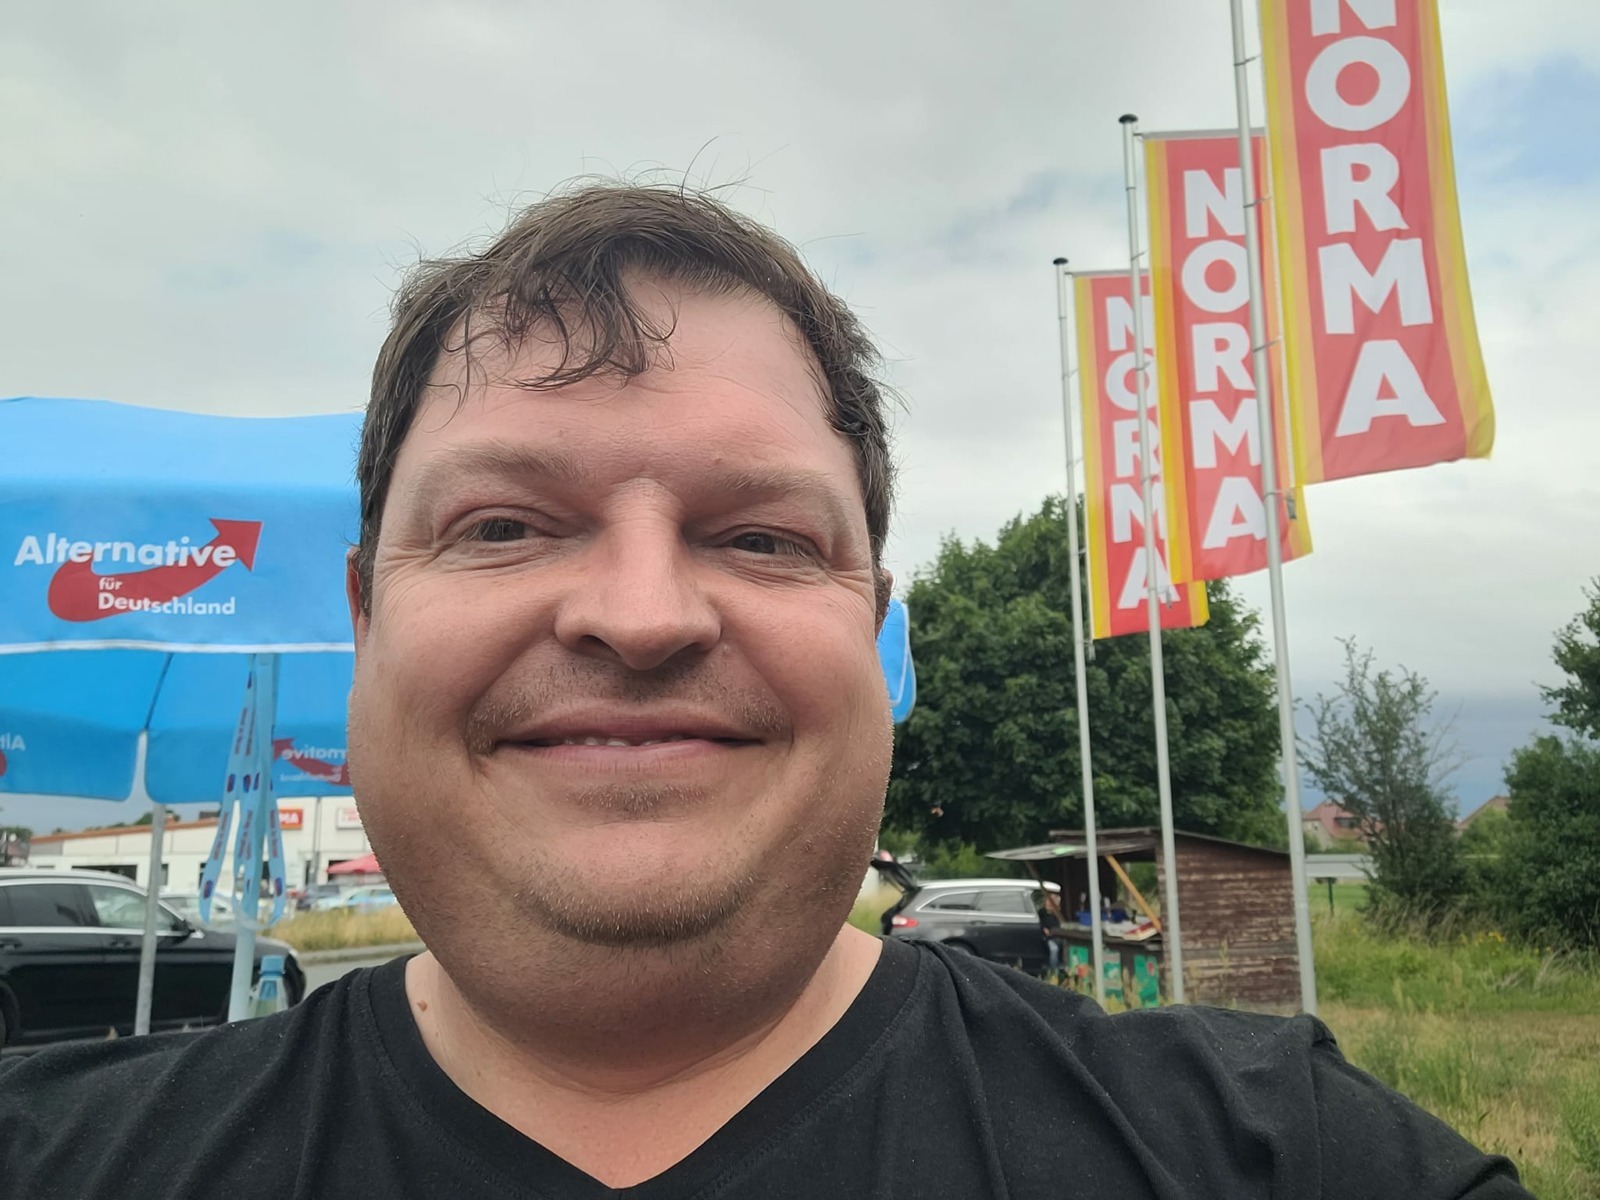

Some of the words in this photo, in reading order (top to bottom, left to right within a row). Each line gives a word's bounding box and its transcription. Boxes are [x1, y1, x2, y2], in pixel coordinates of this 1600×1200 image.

[1181, 168, 1267, 549] NORMA
[14, 532, 237, 567] Alternative
[99, 577, 123, 590] für
[98, 592, 236, 615] Deutschland
